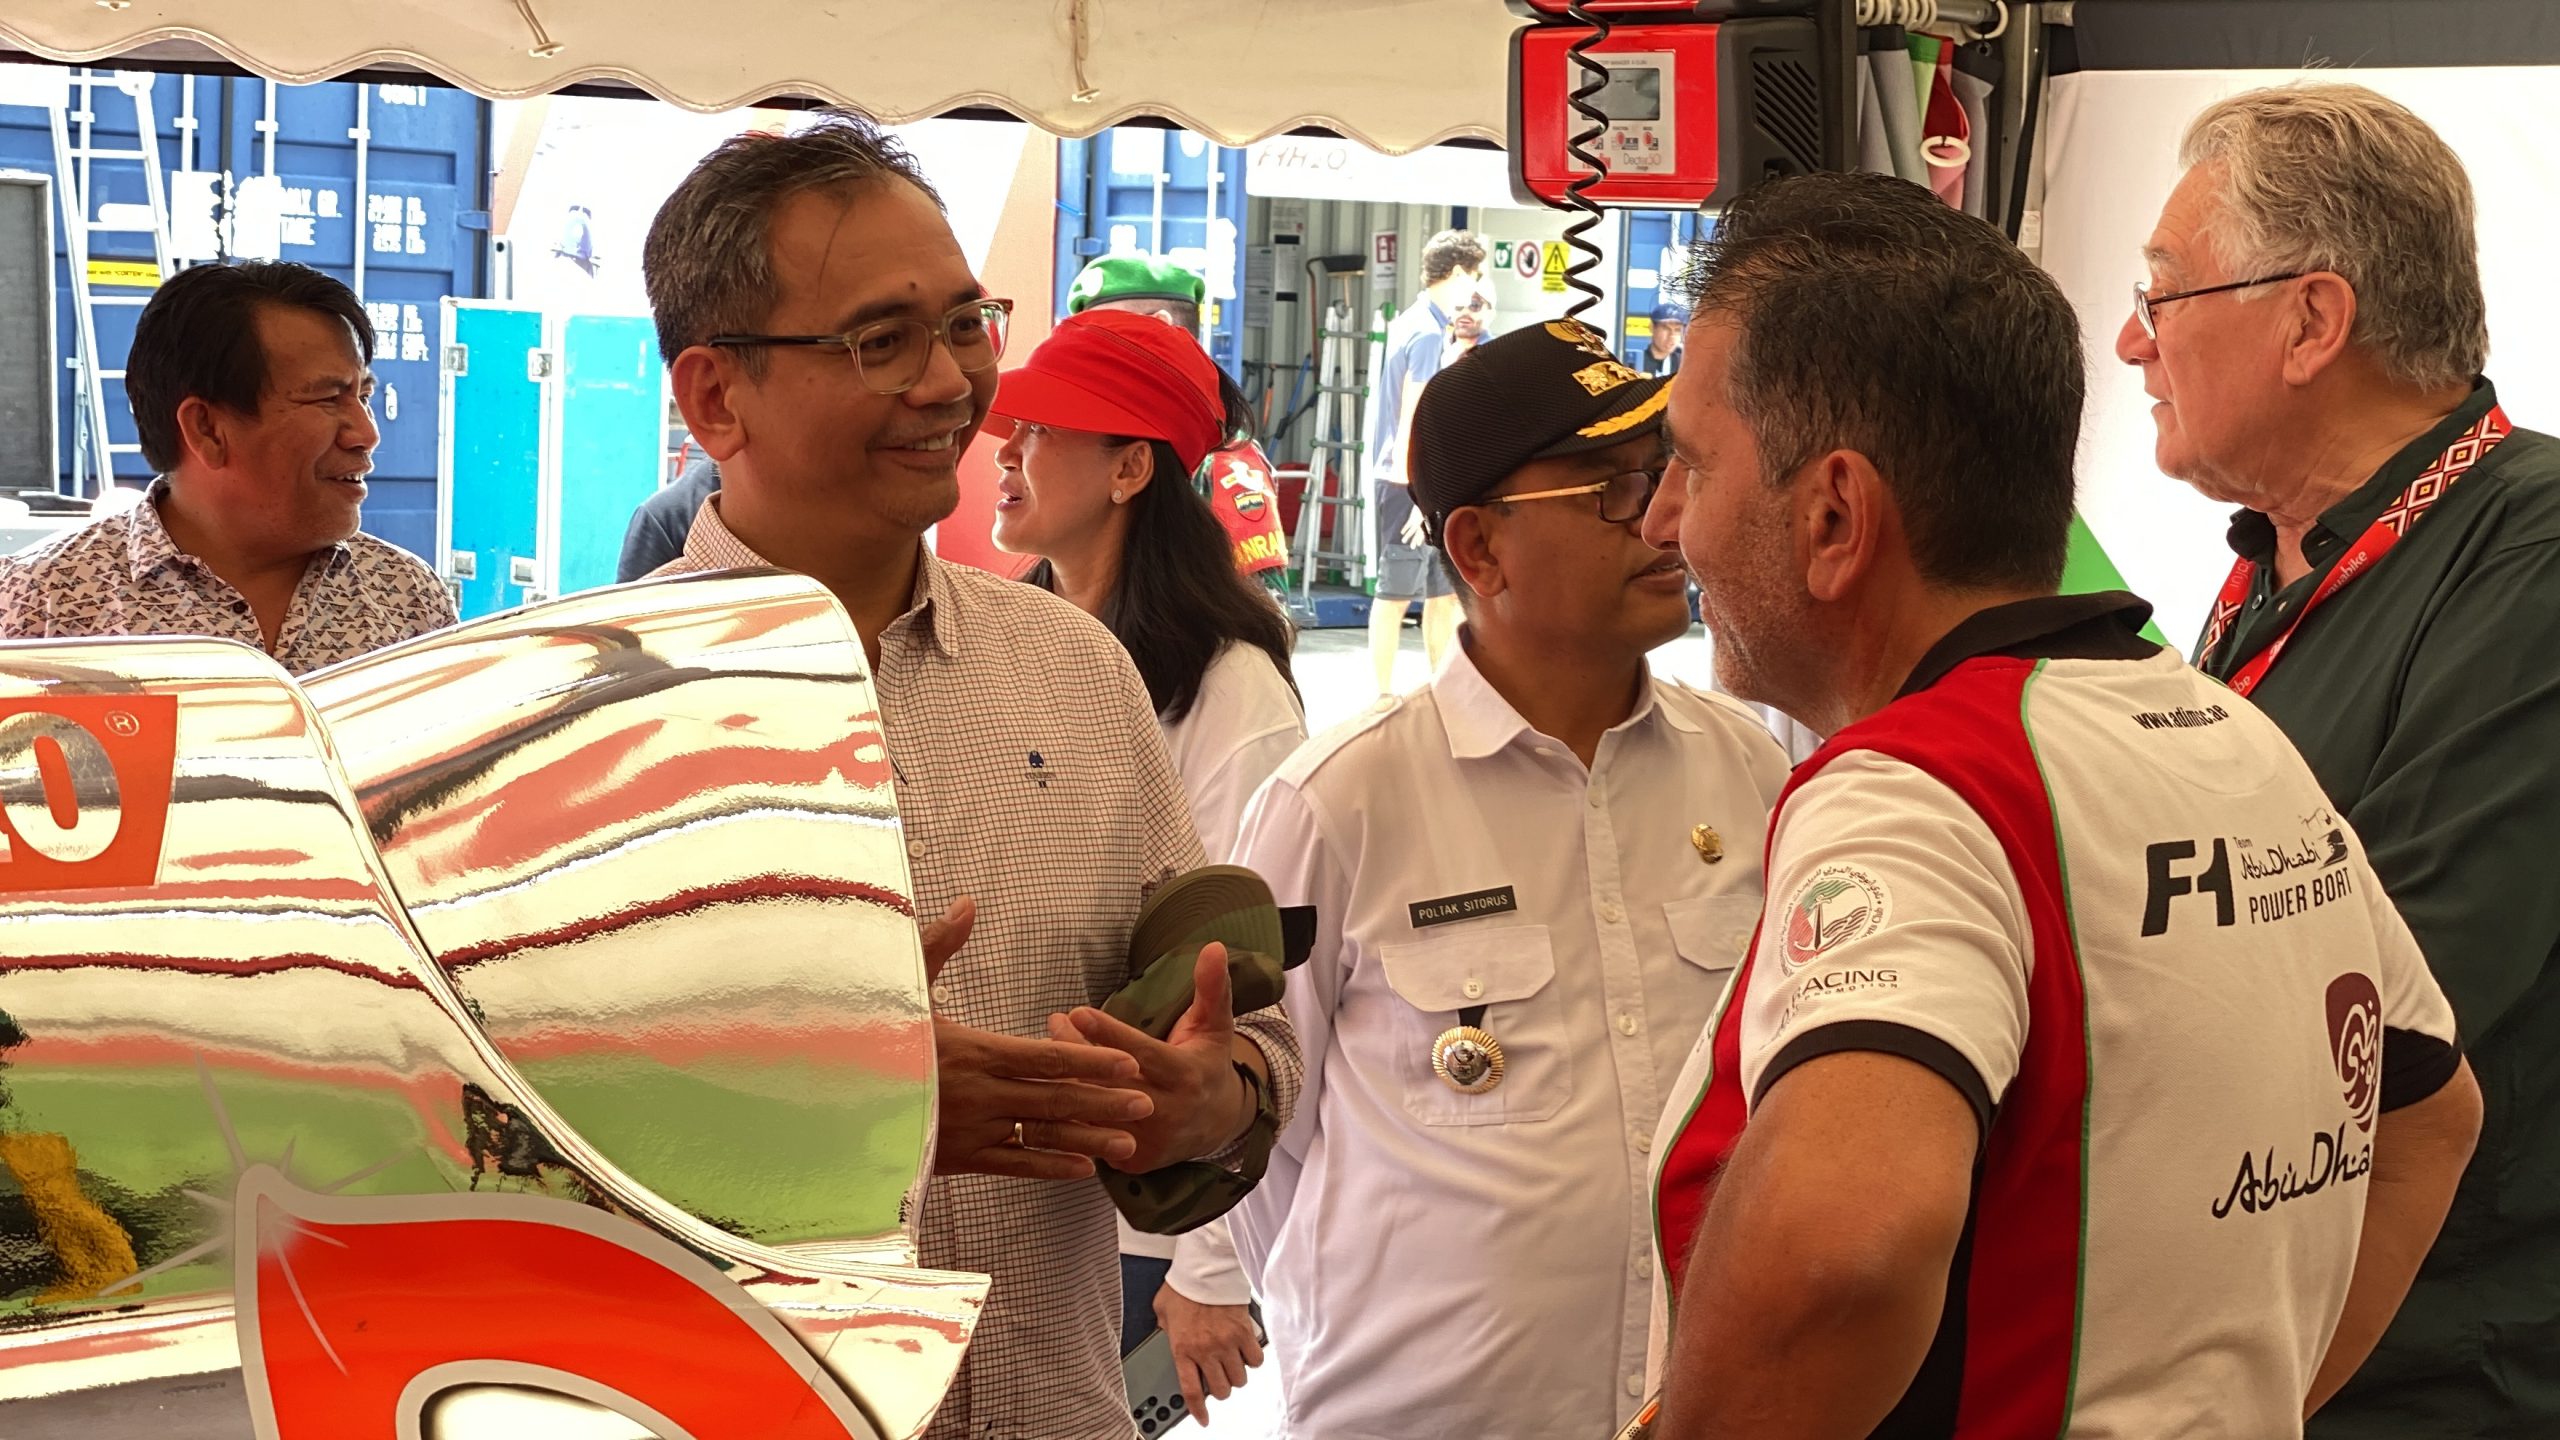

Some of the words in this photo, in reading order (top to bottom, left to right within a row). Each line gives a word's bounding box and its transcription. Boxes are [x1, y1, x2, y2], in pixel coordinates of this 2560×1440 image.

[2132, 704, 2230, 730] www.adimsc.ae
[2233, 836, 2254, 849] Team
[2141, 838, 2236, 938] F1
[2249, 884, 2308, 925] POWER
[2313, 866, 2353, 908] BOAT
[1418, 903, 1460, 920] POLTAK
[1463, 894, 1509, 912] SITORUS
